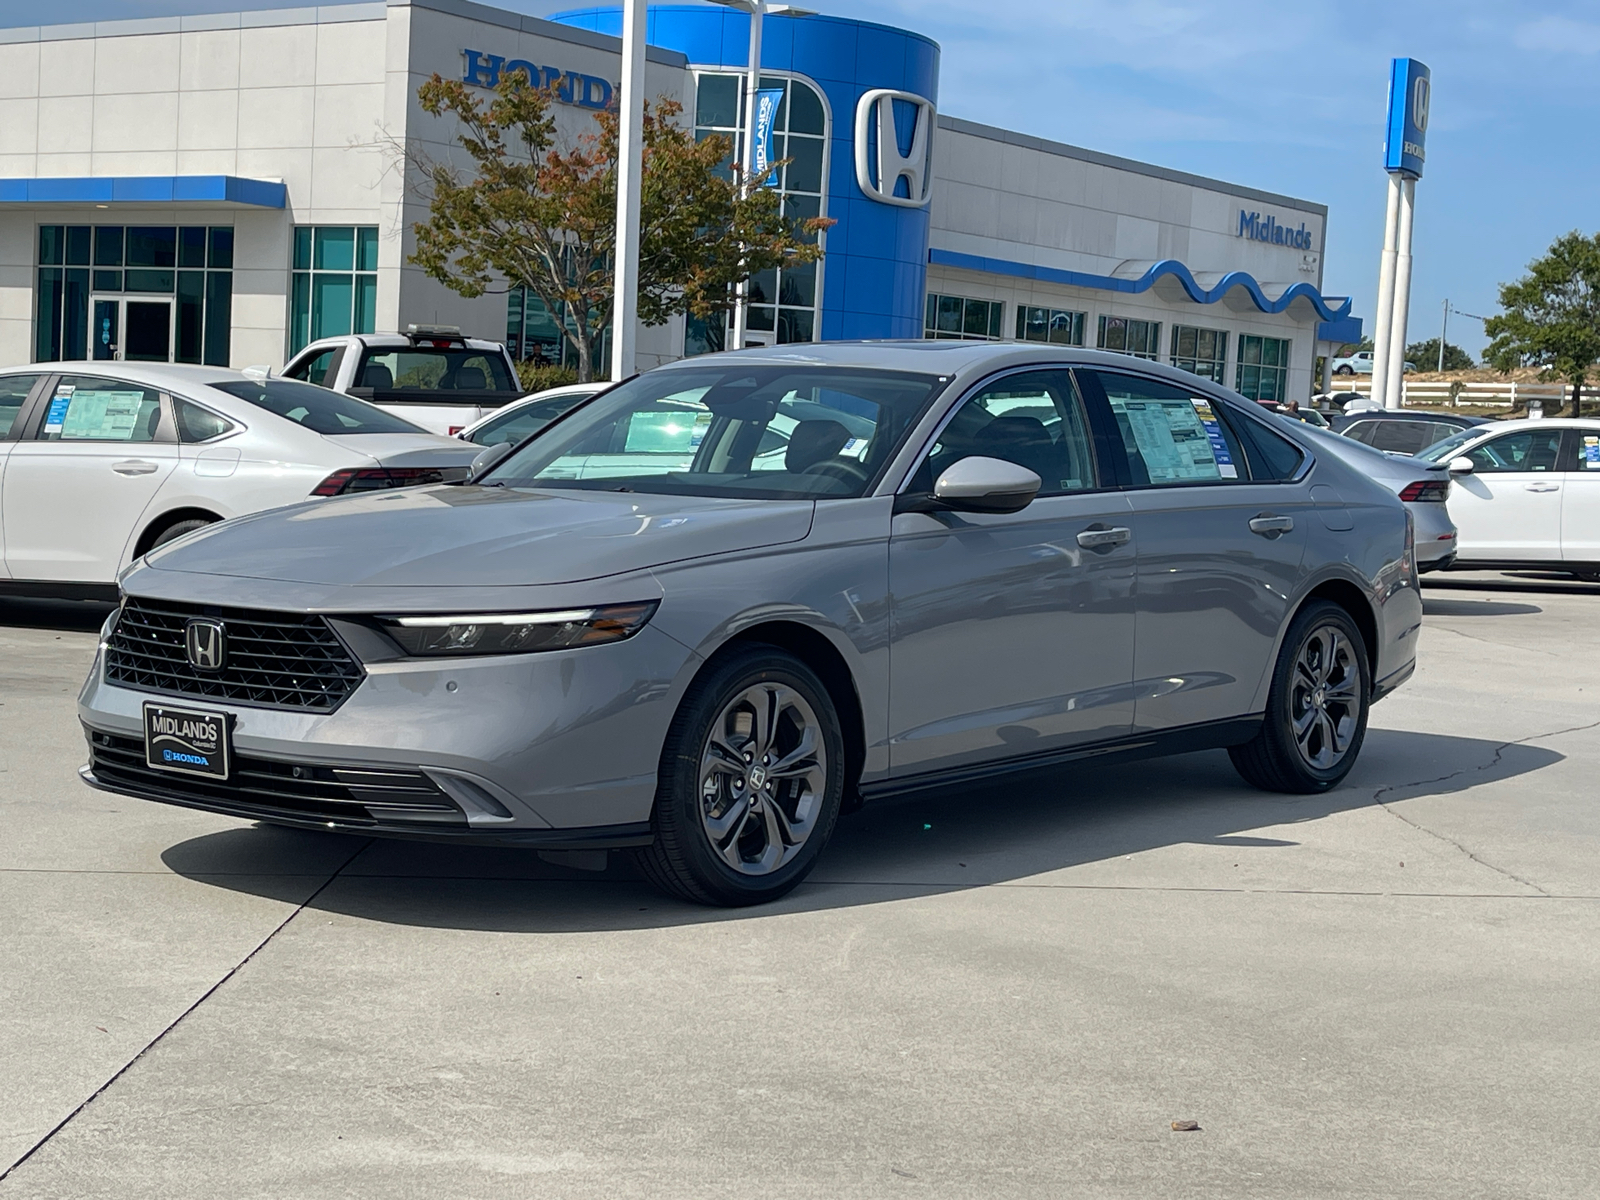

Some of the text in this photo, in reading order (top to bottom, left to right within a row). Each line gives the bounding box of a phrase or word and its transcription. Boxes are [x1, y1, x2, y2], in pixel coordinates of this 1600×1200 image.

[463, 48, 622, 113] HOND
[1239, 210, 1312, 250] Midlands
[152, 715, 218, 741] MIDLANDS
[172, 752, 209, 766] HONDA
